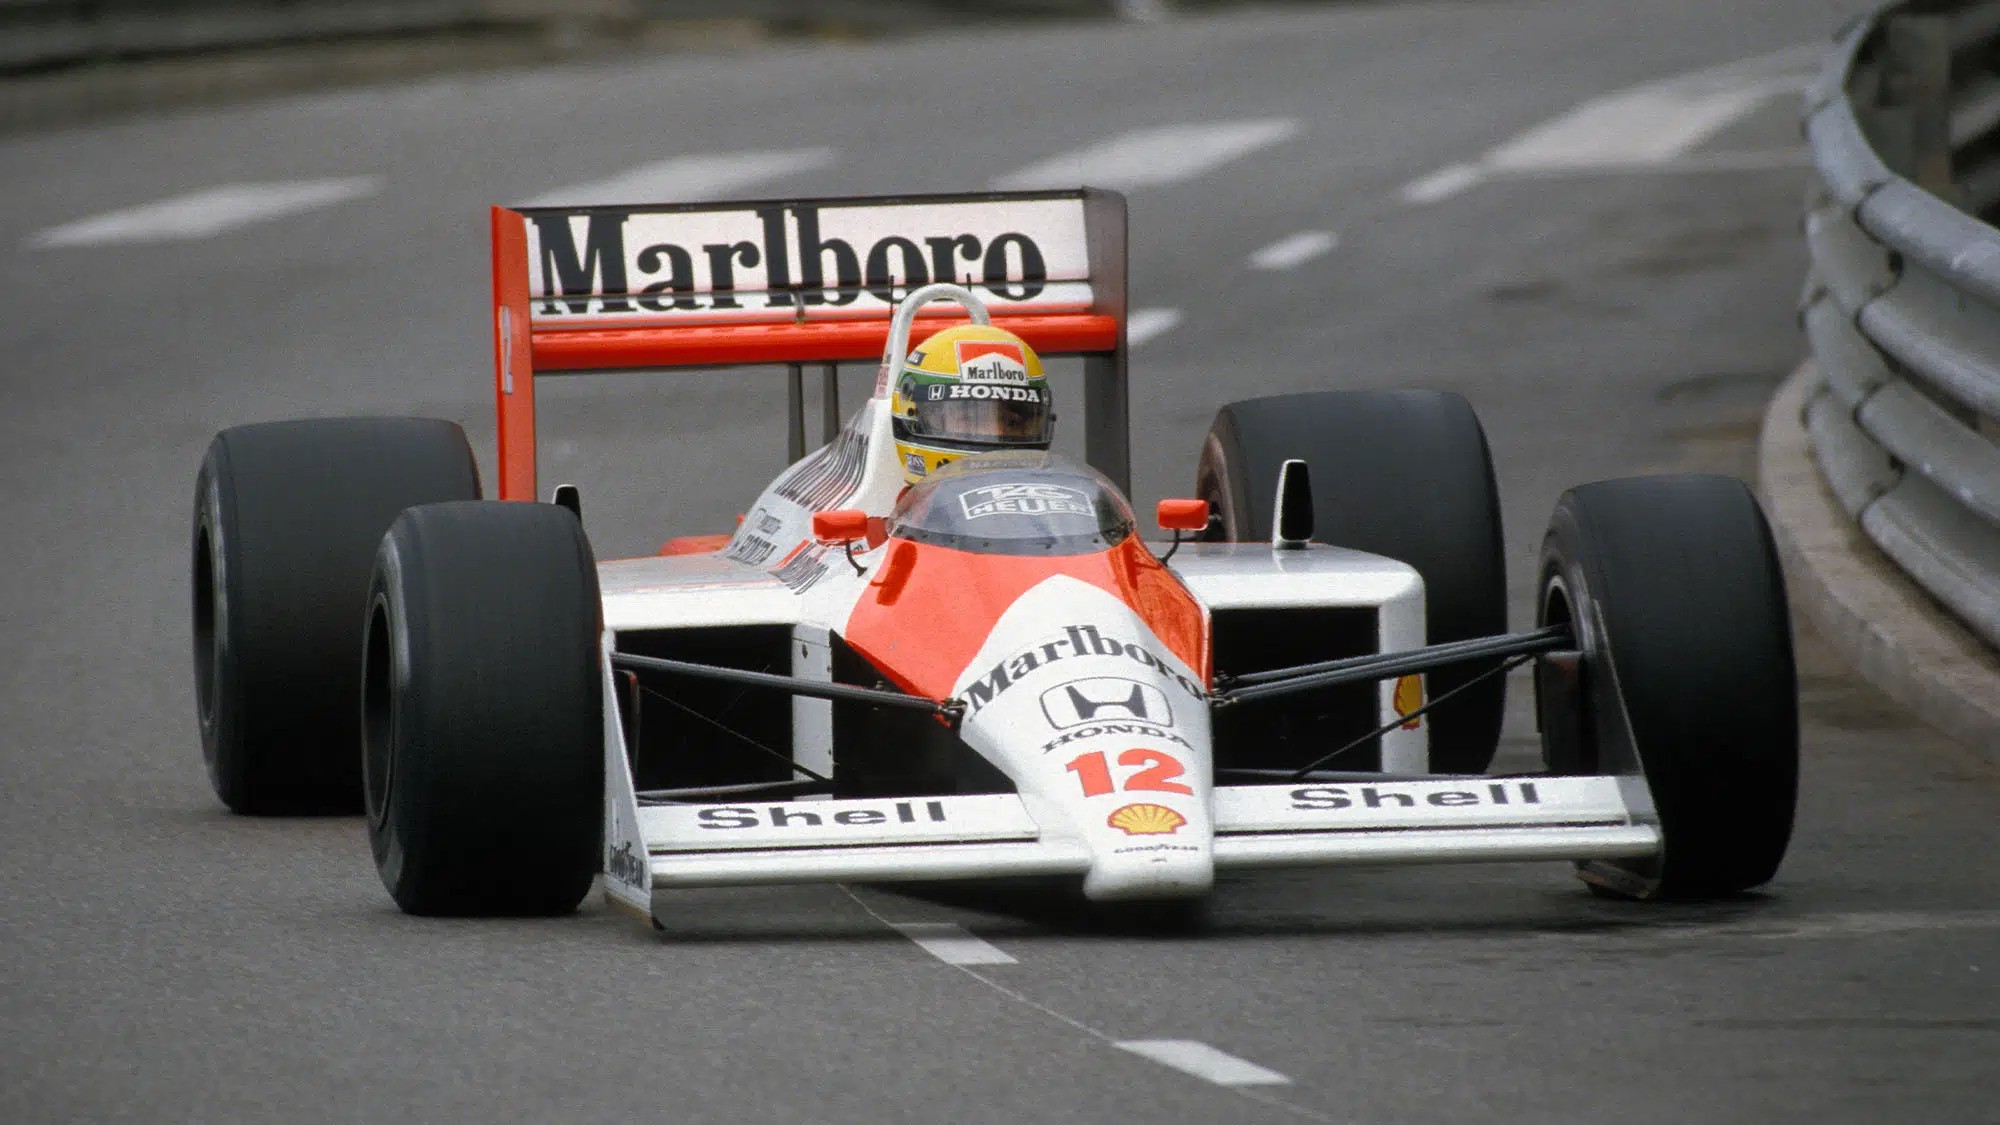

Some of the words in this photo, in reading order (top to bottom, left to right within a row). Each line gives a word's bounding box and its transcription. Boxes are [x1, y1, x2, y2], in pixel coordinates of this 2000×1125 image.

[538, 206, 1047, 315] Marlboro
[967, 362, 1024, 381] Marlboro
[950, 385, 1040, 403] HONDA
[971, 499, 1089, 513] HEUER
[963, 624, 1206, 722] Marlboro
[1041, 725, 1195, 754] HONDA
[1065, 748, 1194, 798] 12
[1290, 783, 1540, 809] Shell
[698, 801, 946, 829] Shell
